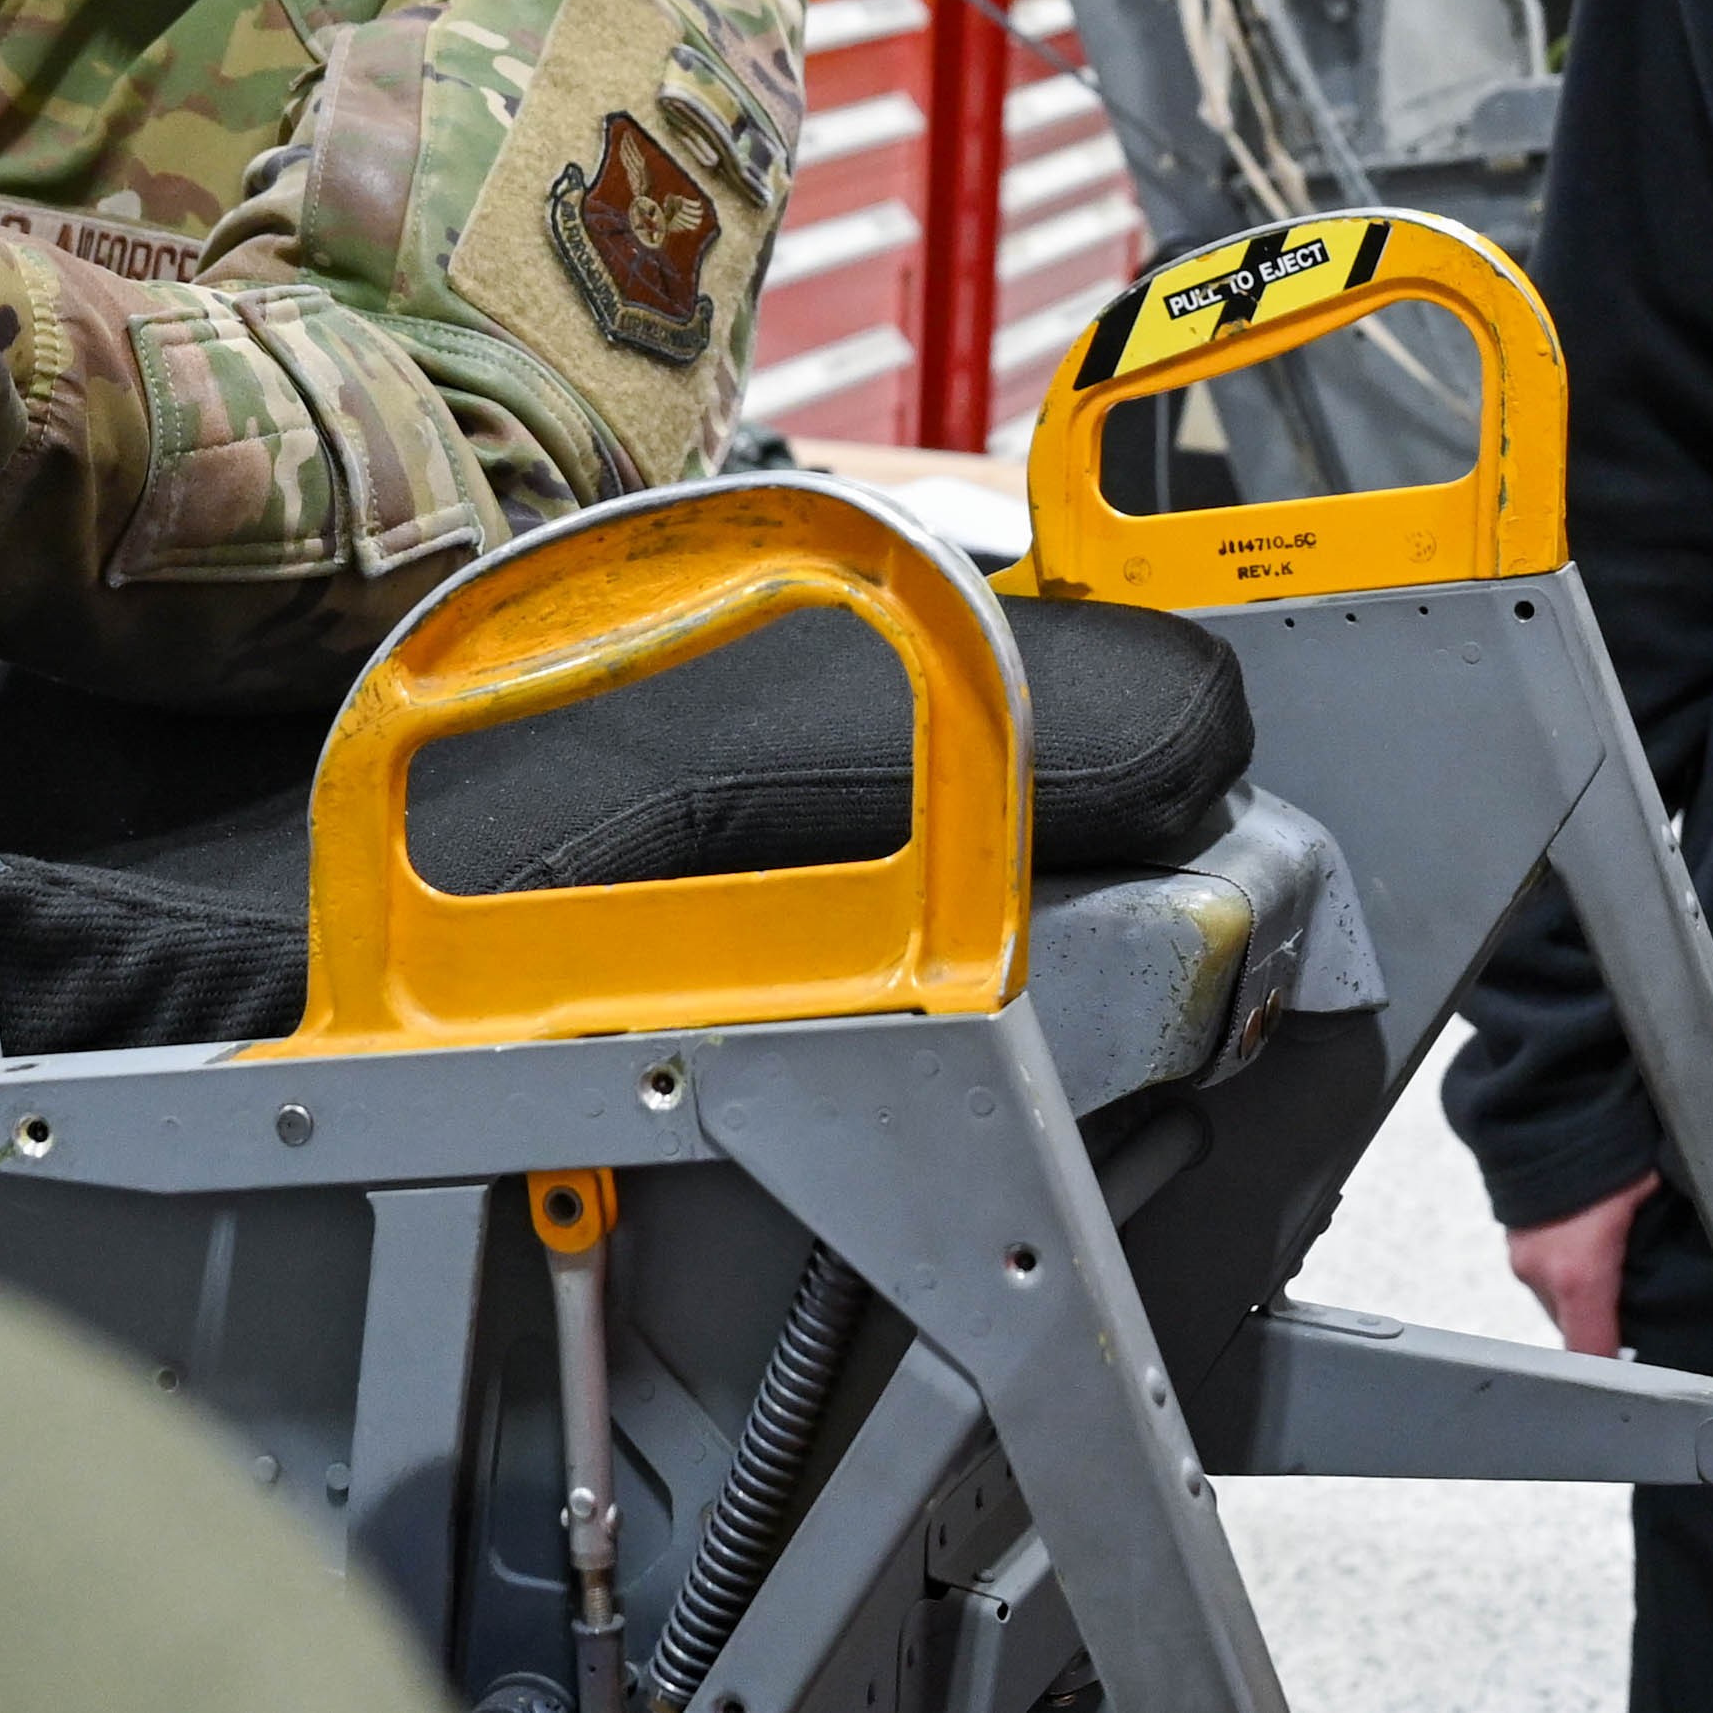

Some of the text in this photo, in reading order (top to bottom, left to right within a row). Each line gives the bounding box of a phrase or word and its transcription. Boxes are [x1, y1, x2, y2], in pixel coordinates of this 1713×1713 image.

[1169, 243, 1322, 316] PULL TO EJECT
